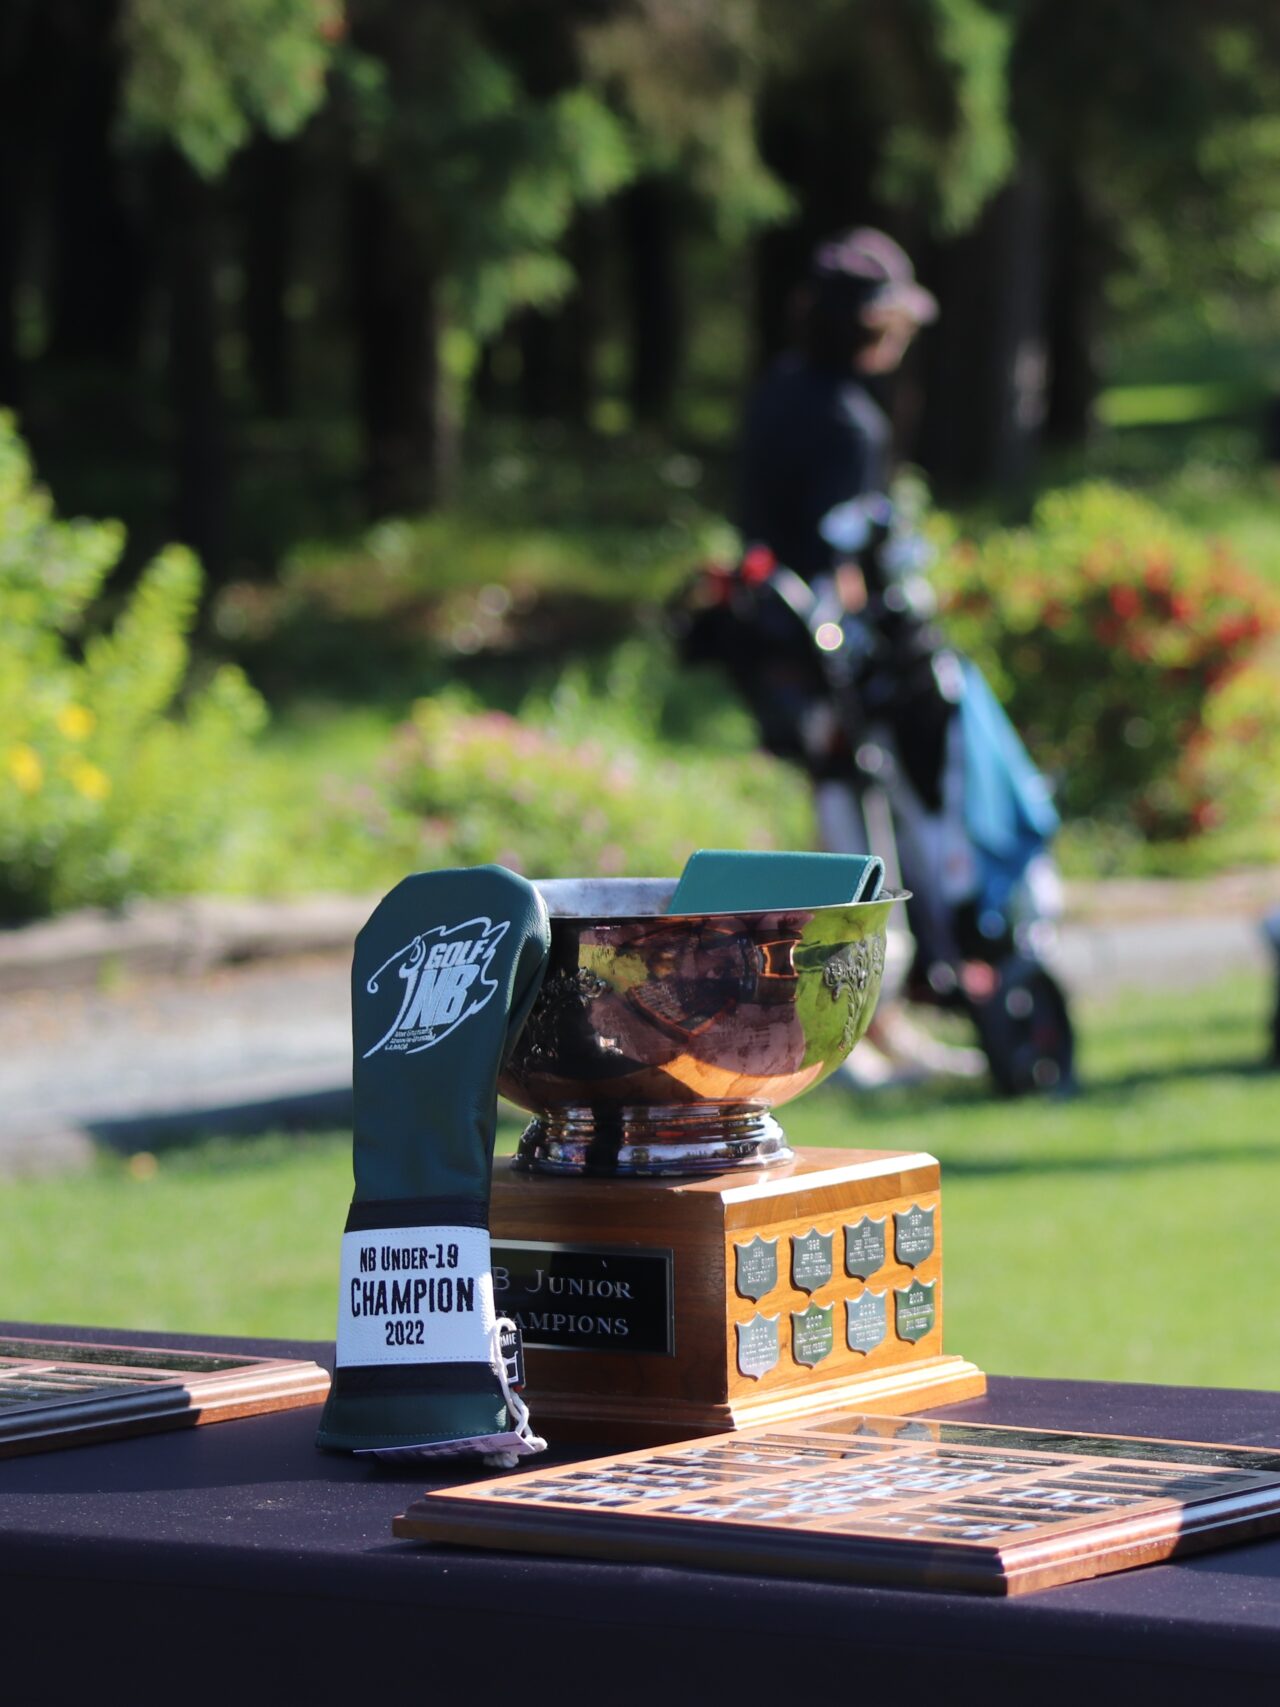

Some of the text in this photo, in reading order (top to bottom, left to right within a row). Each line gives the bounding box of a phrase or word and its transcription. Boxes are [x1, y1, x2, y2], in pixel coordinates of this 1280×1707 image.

[424, 939, 489, 970] GOLF
[400, 964, 480, 1029] NB
[360, 1243, 459, 1273] NB UNDER-19
[351, 1277, 474, 1318] CHAMPION
[525, 1269, 635, 1300] JUNIOR
[385, 1320, 425, 1346] 2022
